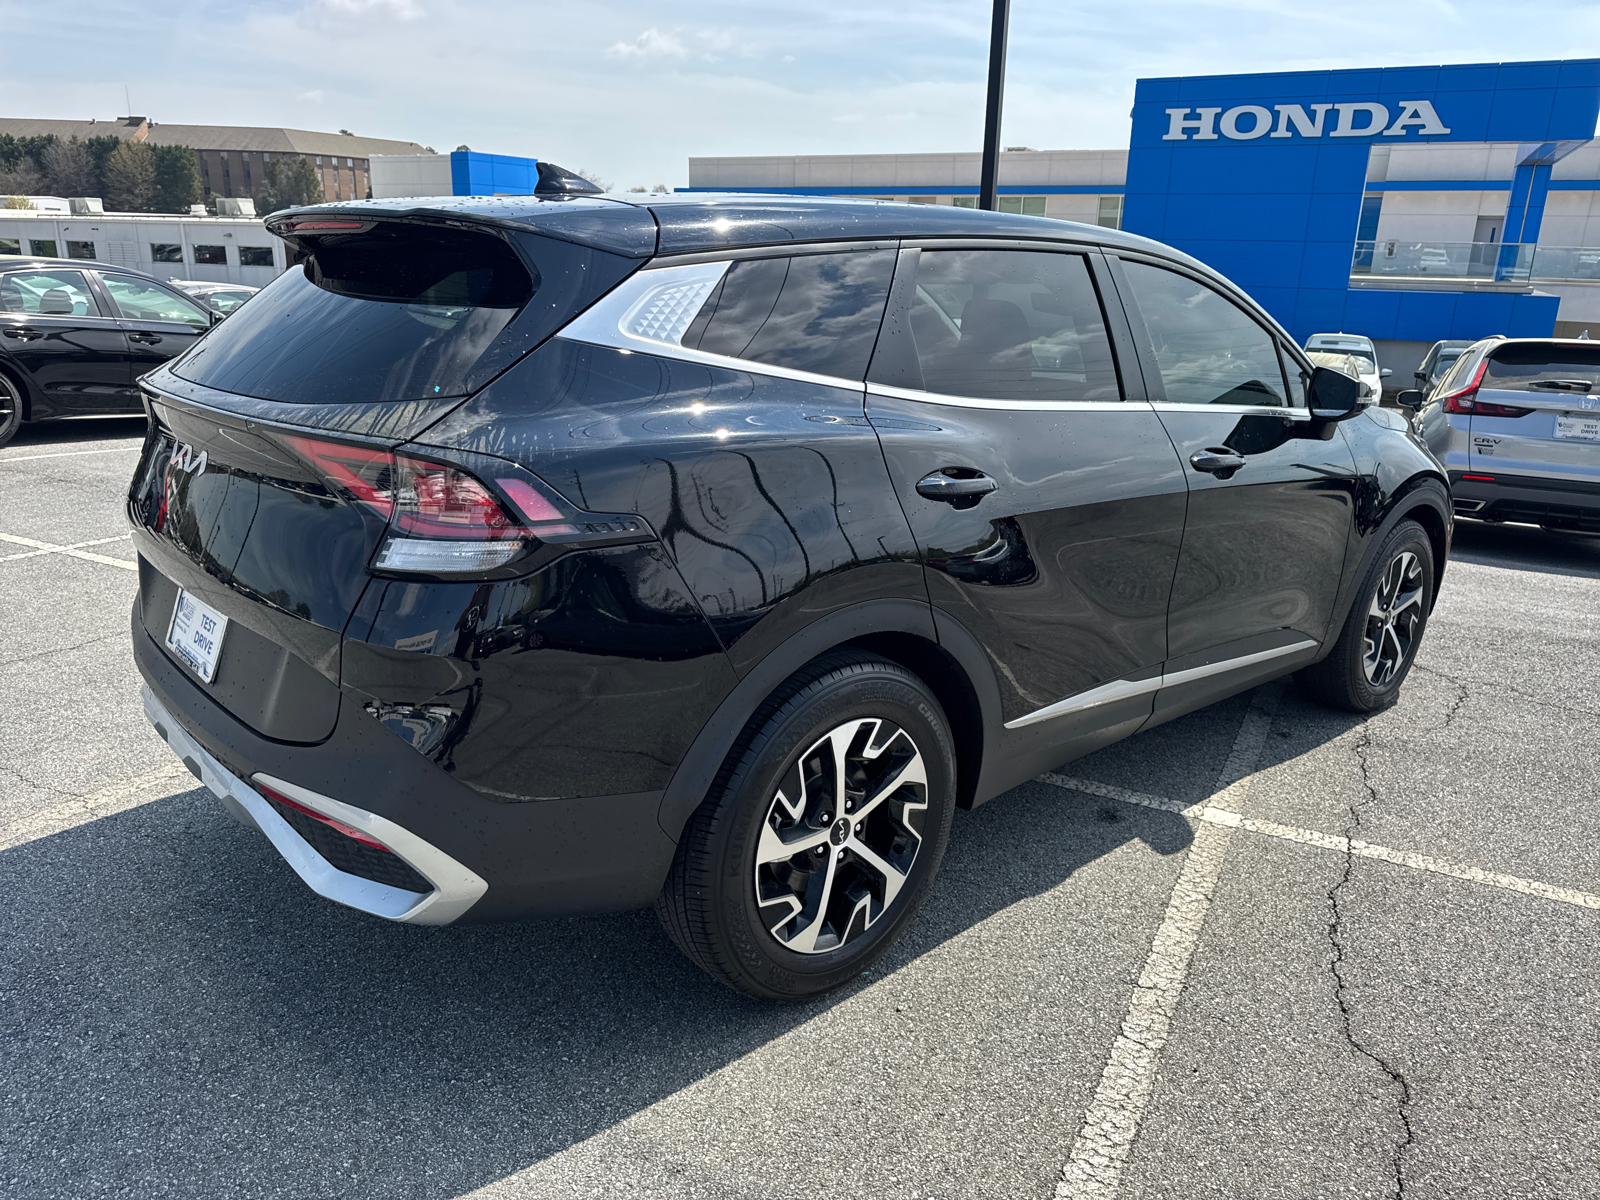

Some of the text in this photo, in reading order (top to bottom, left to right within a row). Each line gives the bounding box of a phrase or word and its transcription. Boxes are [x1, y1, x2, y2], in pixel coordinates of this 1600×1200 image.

[1162, 100, 1451, 140] HONDA
[200, 613, 217, 635] TEST
[193, 630, 213, 655] DRIVE
